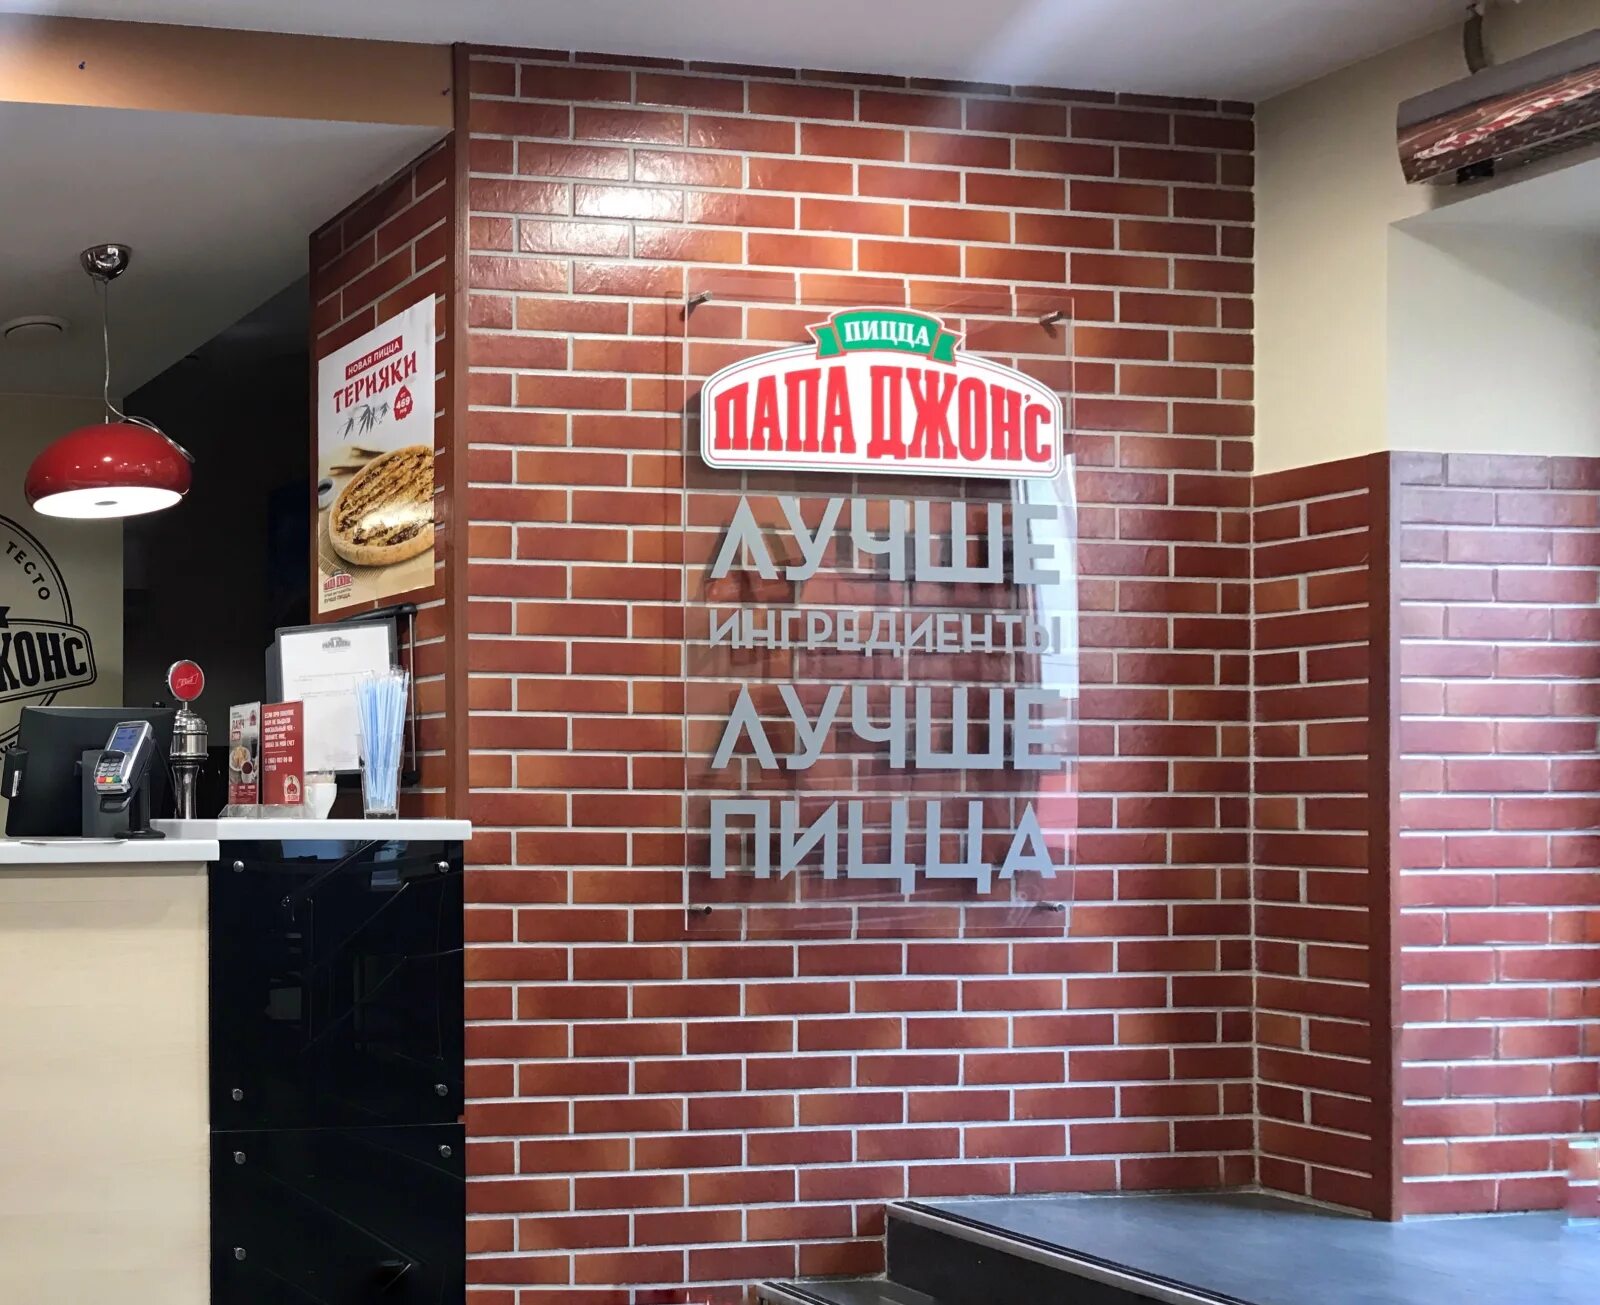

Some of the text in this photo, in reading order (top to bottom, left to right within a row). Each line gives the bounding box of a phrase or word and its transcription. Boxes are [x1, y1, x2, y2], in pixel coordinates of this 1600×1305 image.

[348, 340, 400, 376] НОВАЯ ПИЦЦА
[843, 319, 931, 349] ПИЦЦА
[333, 350, 417, 414] ТЕРИЯКИ
[396, 396, 410, 409] 469
[714, 365, 1052, 463] ПАПА ДЖОН'С
[710, 493, 1061, 585] ЛУЧШЕ
[6, 541, 50, 600] ТЕСТО
[709, 608, 1062, 657] ИНГРЕДИЕНТЫ
[711, 683, 1061, 770] ЛУЧШЕ
[710, 799, 1057, 895] ПИЦЦА
